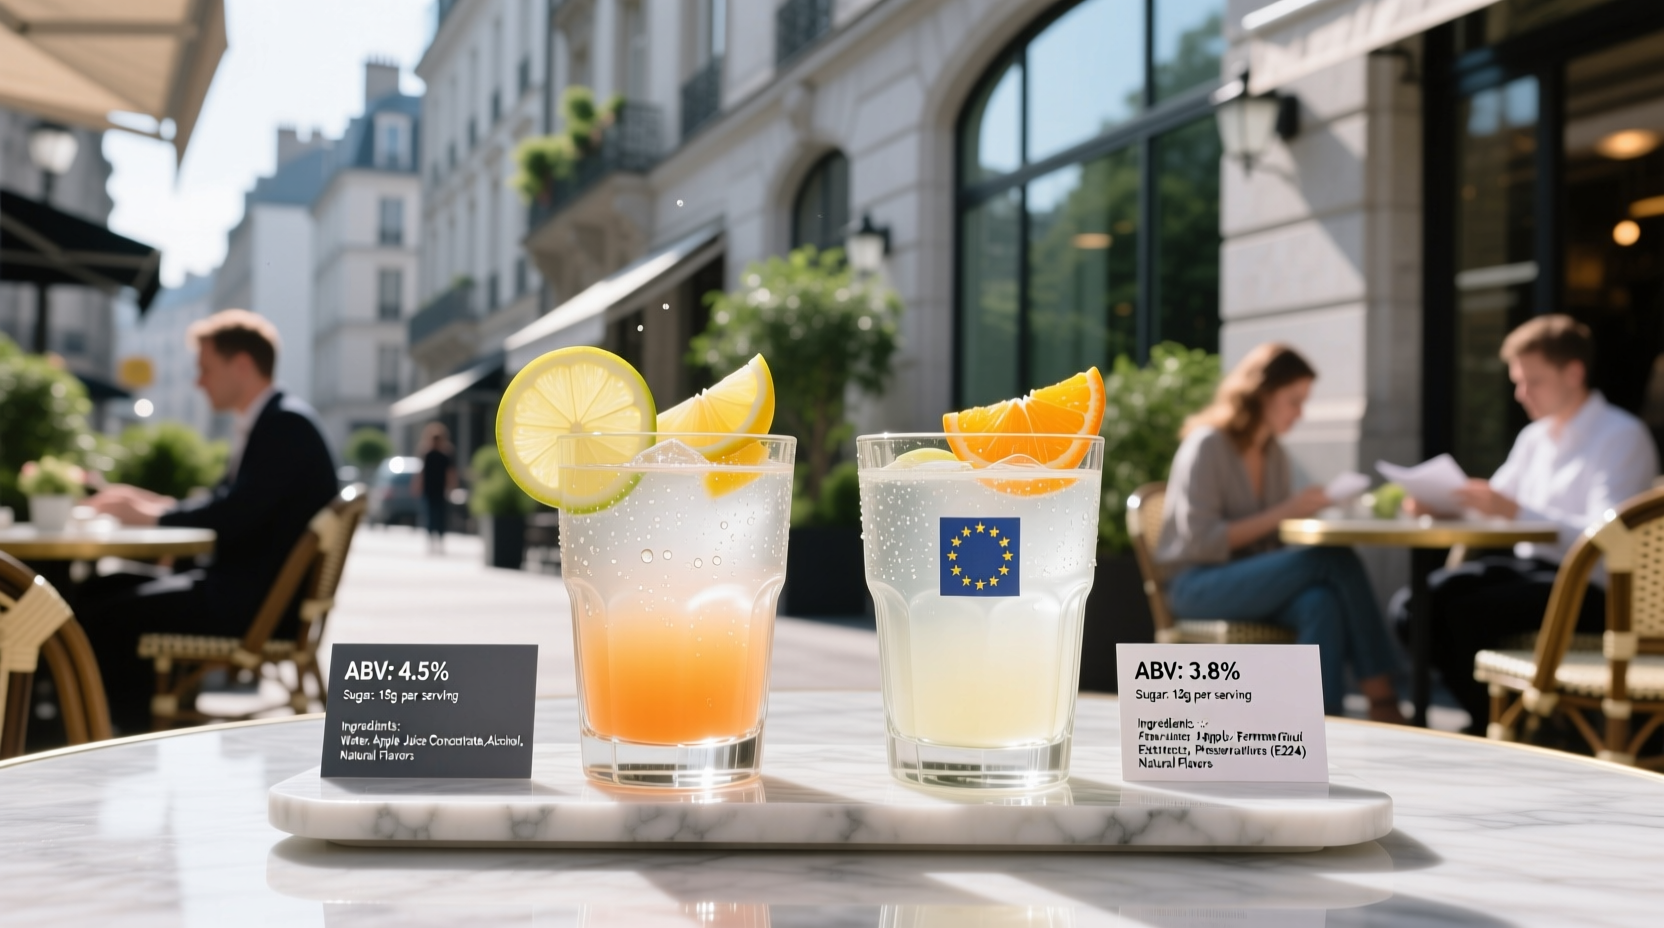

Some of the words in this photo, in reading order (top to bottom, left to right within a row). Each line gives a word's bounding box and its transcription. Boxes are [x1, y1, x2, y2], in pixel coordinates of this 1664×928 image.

[344, 661, 394, 681] ABV:
[399, 661, 449, 681] 4.5%
[1135, 661, 1183, 680] ABV:
[1190, 661, 1240, 680] 3.8%
[401, 691, 417, 703] per
[1194, 690, 1211, 703] per
[1215, 690, 1251, 702] serving
